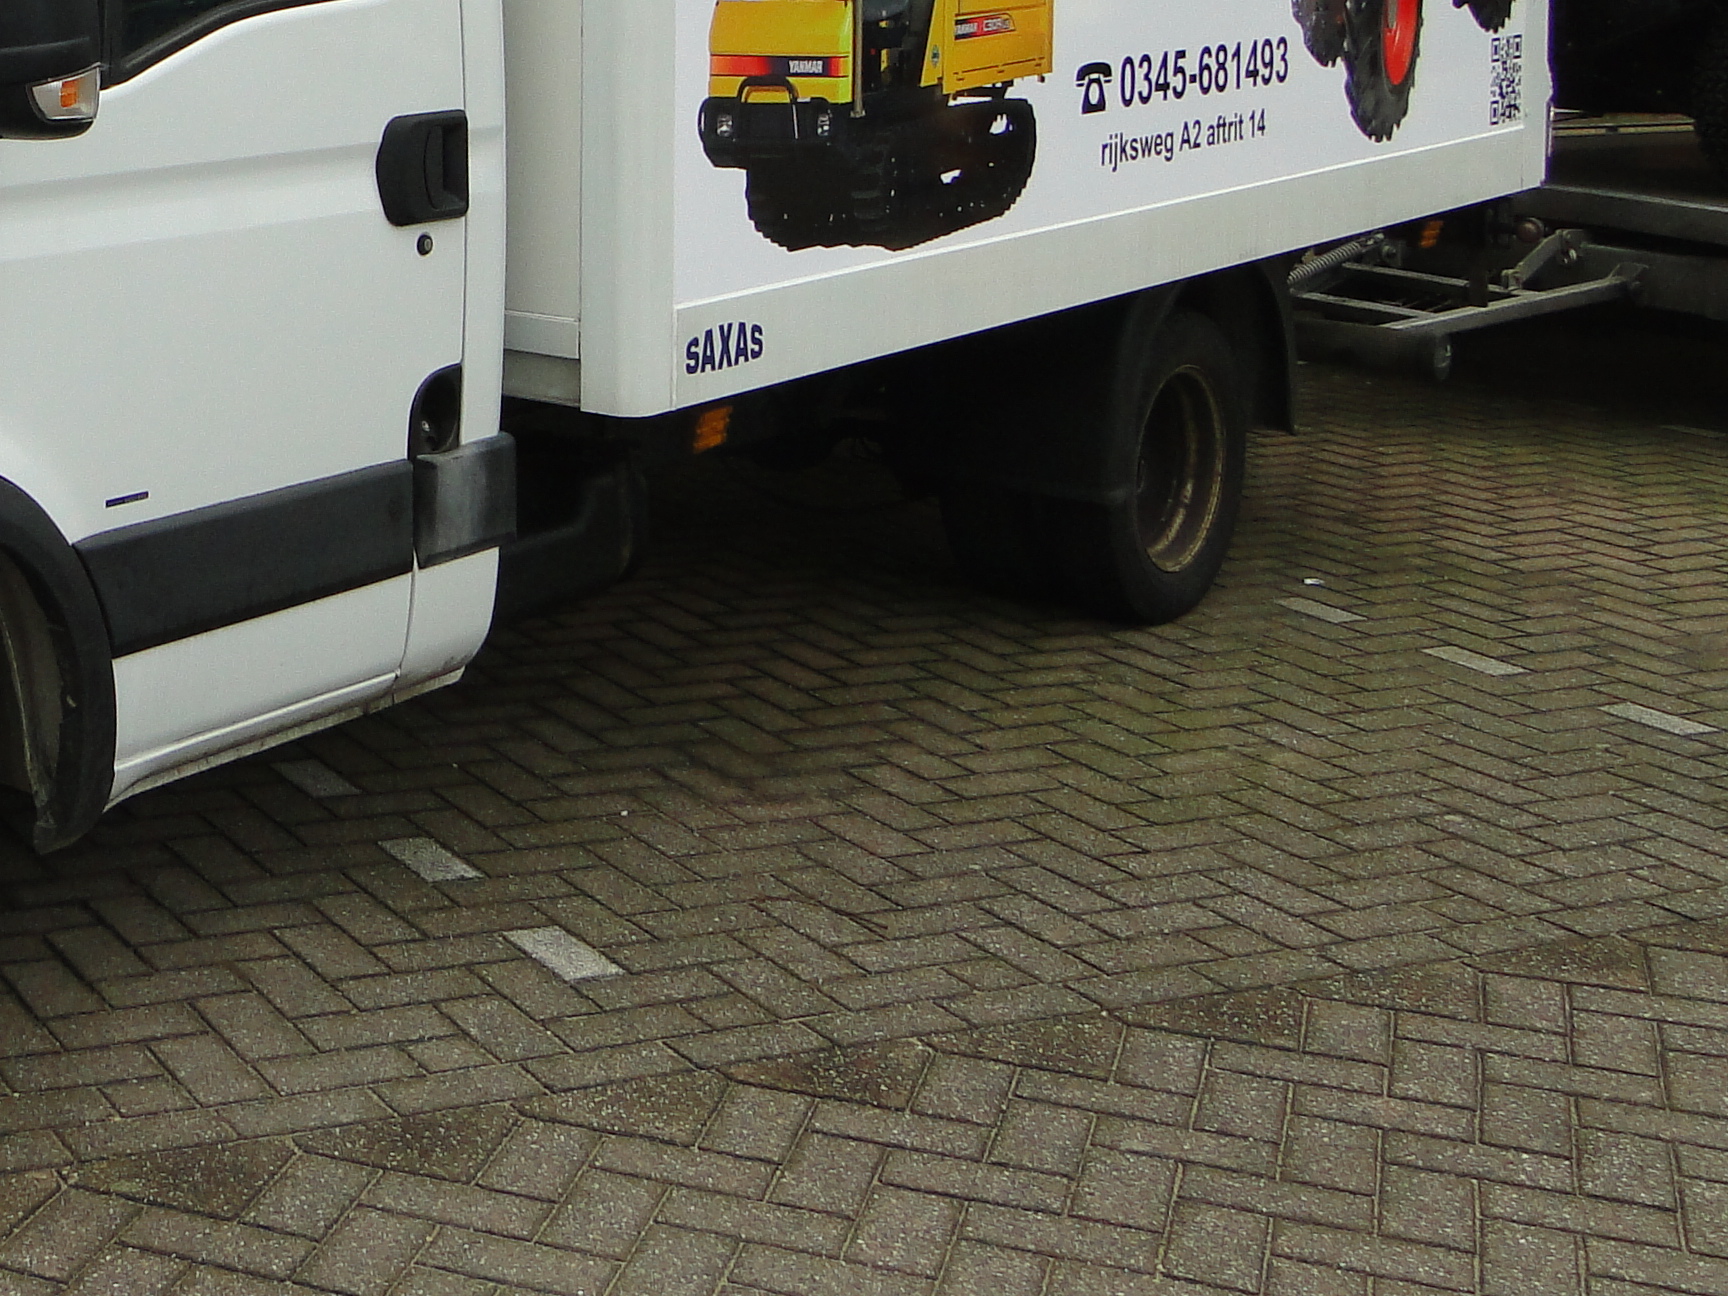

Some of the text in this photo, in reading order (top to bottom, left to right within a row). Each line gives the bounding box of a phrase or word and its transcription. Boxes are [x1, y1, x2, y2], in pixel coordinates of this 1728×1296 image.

[1121, 36, 1289, 107] 0345-681493
[1101, 108, 1266, 172] rijksweg A2 aftrit 14
[685, 321, 764, 375] SAXAS
